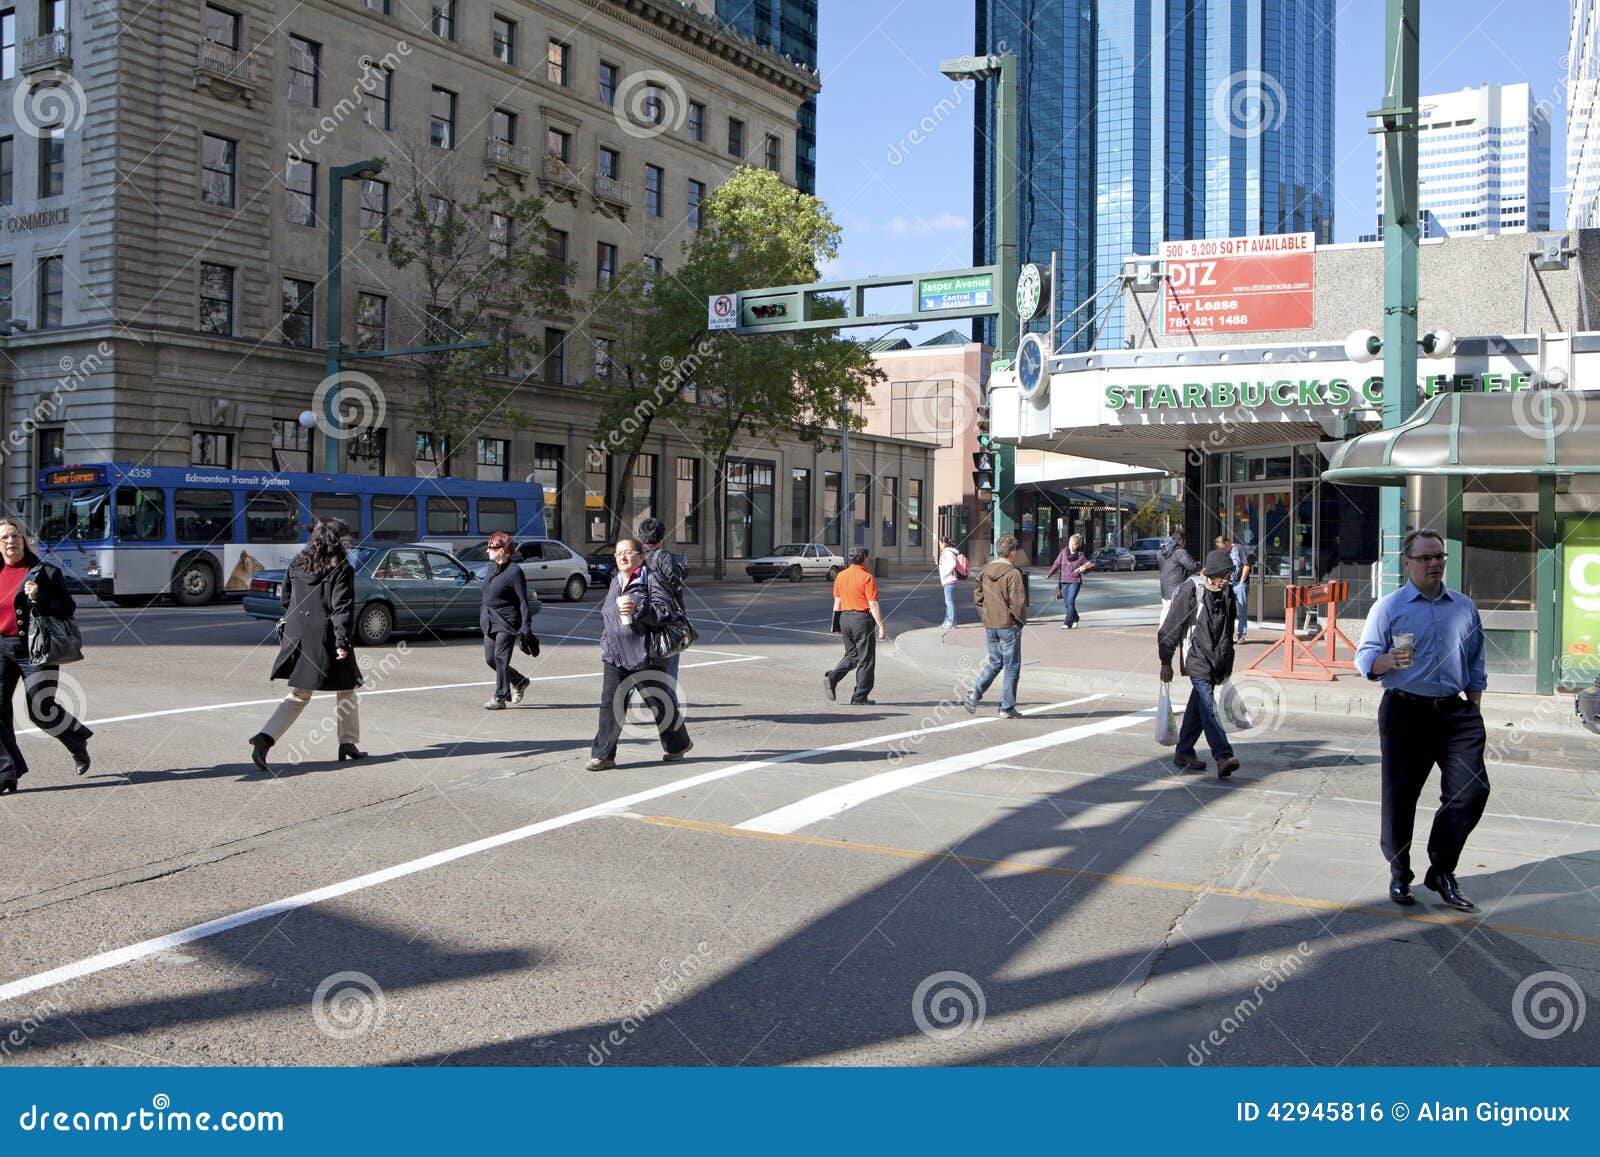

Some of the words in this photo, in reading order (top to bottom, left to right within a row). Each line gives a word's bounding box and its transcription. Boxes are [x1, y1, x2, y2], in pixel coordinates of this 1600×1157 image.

[8, 207, 69, 233] COMMERCE
[1166, 244, 1183, 257] 500
[1191, 241, 1217, 257] 9,200
[1220, 240, 1233, 254] SQ
[1237, 240, 1248, 253] FT
[1251, 236, 1307, 253] AVAILABLE
[1168, 261, 1217, 287] DTZ
[922, 281, 953, 293] Jasper
[955, 279, 991, 290] Avenue
[942, 293, 970, 301] Central
[1168, 301, 1192, 313] For
[1196, 300, 1239, 312] Lease
[1169, 317, 1190, 328] 780
[1193, 316, 1214, 327] 421
[1219, 314, 1248, 326] 1488
[1104, 378, 1350, 409] STARBUCKS
[1362, 371, 1533, 404] CFFEE
[128, 468, 151, 478] 4358
[185, 473, 230, 484] Edmonton
[231, 475, 260, 485] Transit
[261, 476, 290, 486] System
